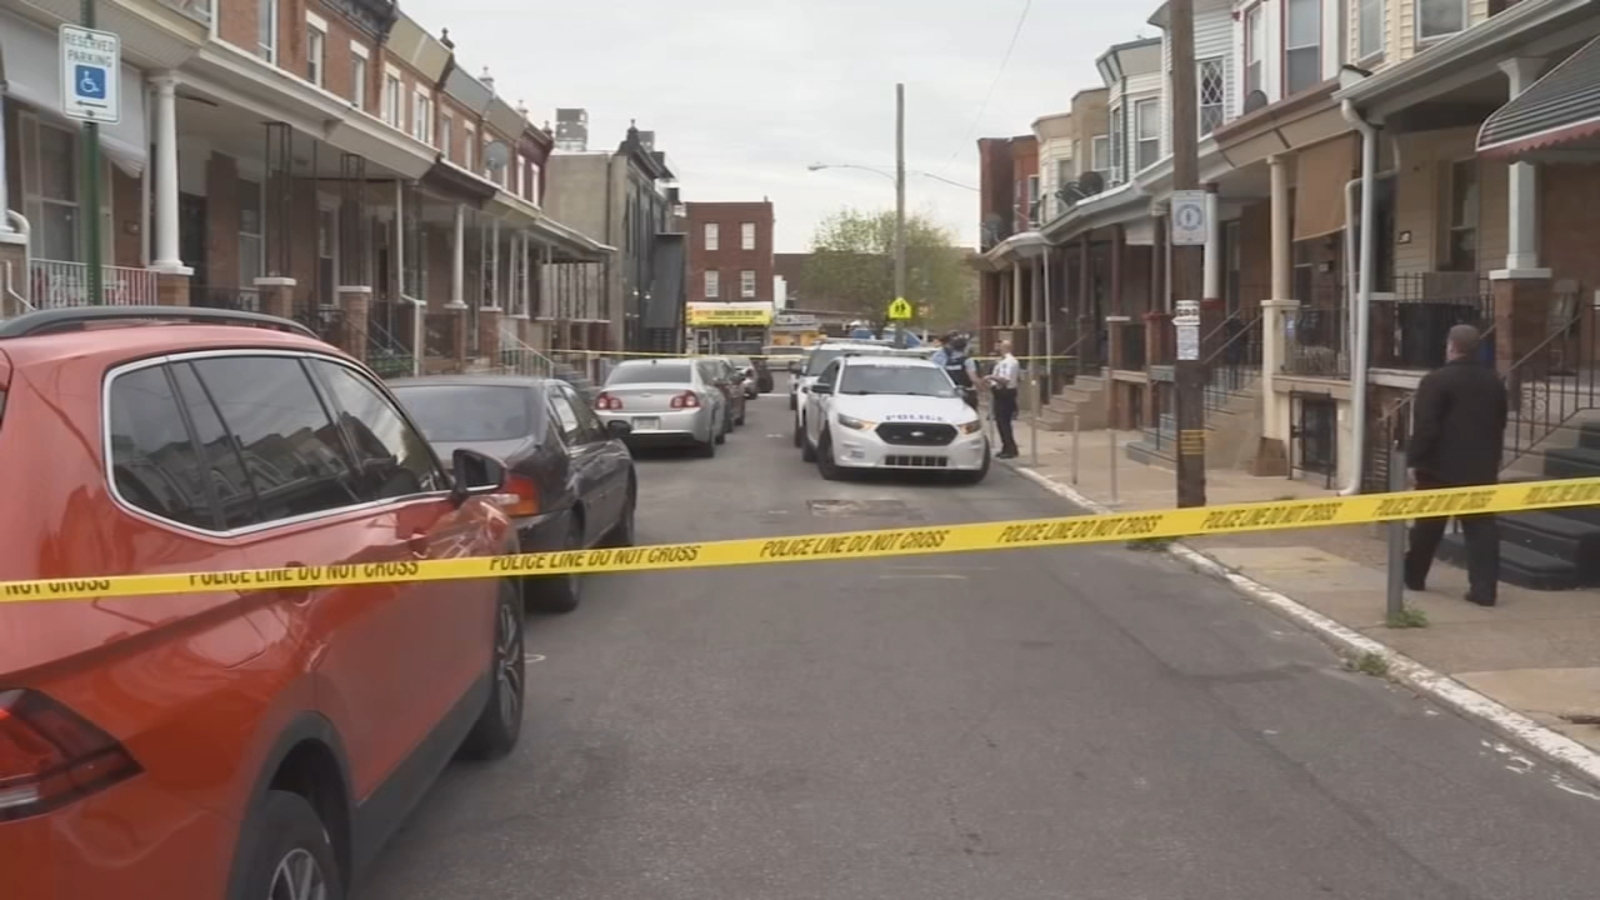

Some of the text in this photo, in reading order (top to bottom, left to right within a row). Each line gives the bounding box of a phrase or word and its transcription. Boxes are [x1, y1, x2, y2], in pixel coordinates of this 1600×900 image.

[65, 33, 114, 53] RESERVED
[67, 49, 113, 68] PARKING
[1201, 510, 1246, 529] POLICE
[1302, 502, 1342, 521] CROSS
[997, 515, 1163, 542] POLICE LINE DO NOT CROSS
[760, 530, 950, 557] POLICE LINE DO NOT CROSS
[490, 546, 701, 570] POLICE LINE DO NOT CROSS
[190, 562, 419, 586] POLICE LINE DO NOT CROSS
[6, 583, 41, 595] NOT
